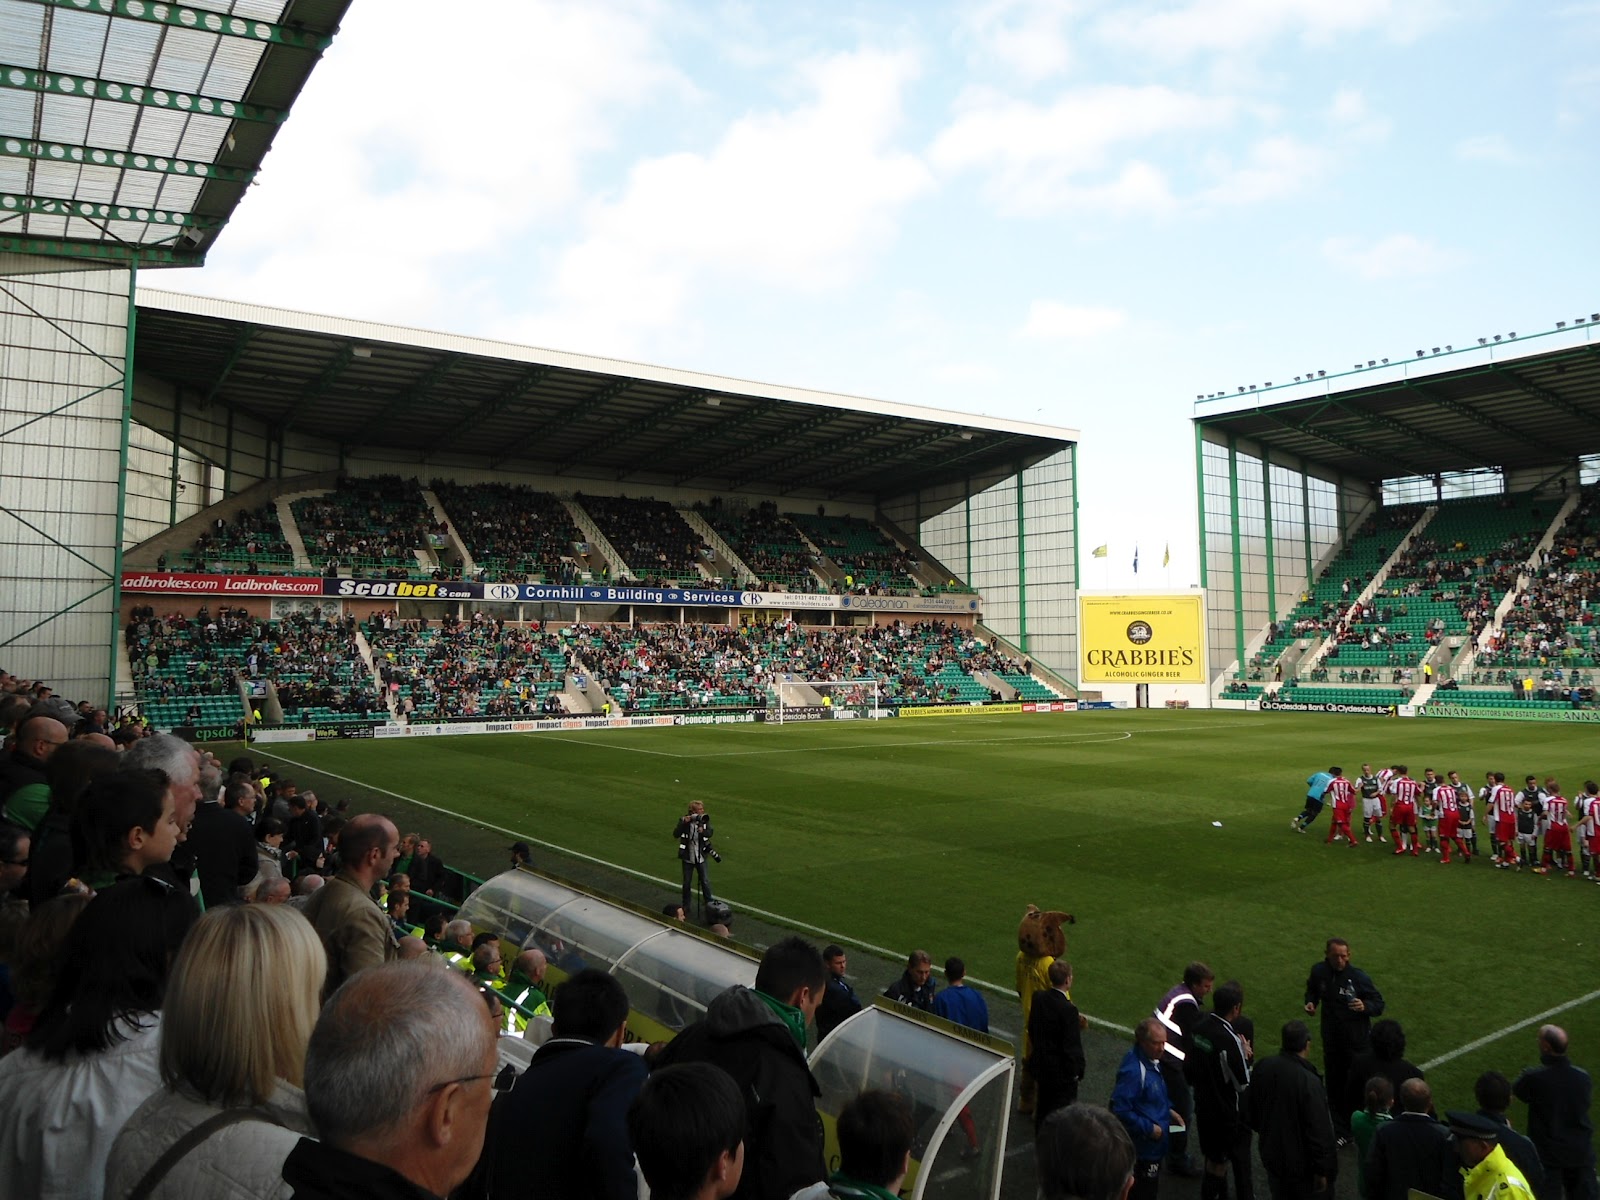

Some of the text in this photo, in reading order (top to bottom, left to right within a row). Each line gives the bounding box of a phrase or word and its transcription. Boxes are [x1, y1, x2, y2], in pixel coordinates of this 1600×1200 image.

[120, 575, 218, 590] adbrokes.com
[224, 578, 319, 592] Ladbrokes.com
[525, 586, 584, 599] Cornhill
[607, 589, 663, 603] Building
[683, 591, 735, 603] Services
[852, 596, 909, 608] Caledonian
[1087, 645, 1193, 668] CRABBIE'S
[1272, 702, 1325, 711] Clydesdale Bank
[1337, 704, 1376, 713] Clydesdale
[834, 710, 854, 719] PUMA
[1428, 707, 1468, 717] ANNAN
[1470, 709, 1501, 717] SOLICITORS
[1502, 710, 1514, 718] AND
[1515, 710, 1536, 718] ESTATE
[1538, 711, 1560, 719] AGENTS
[585, 719, 609, 727] Impact
[610, 718, 628, 727] signs
[631, 717, 654, 725] Impact
[685, 713, 755, 724] concept-group.co.uk
[485, 723, 512, 731] Impact
[513, 722, 533, 730] signs
[536, 721, 562, 729] Impact
[563, 720, 582, 728] signs
